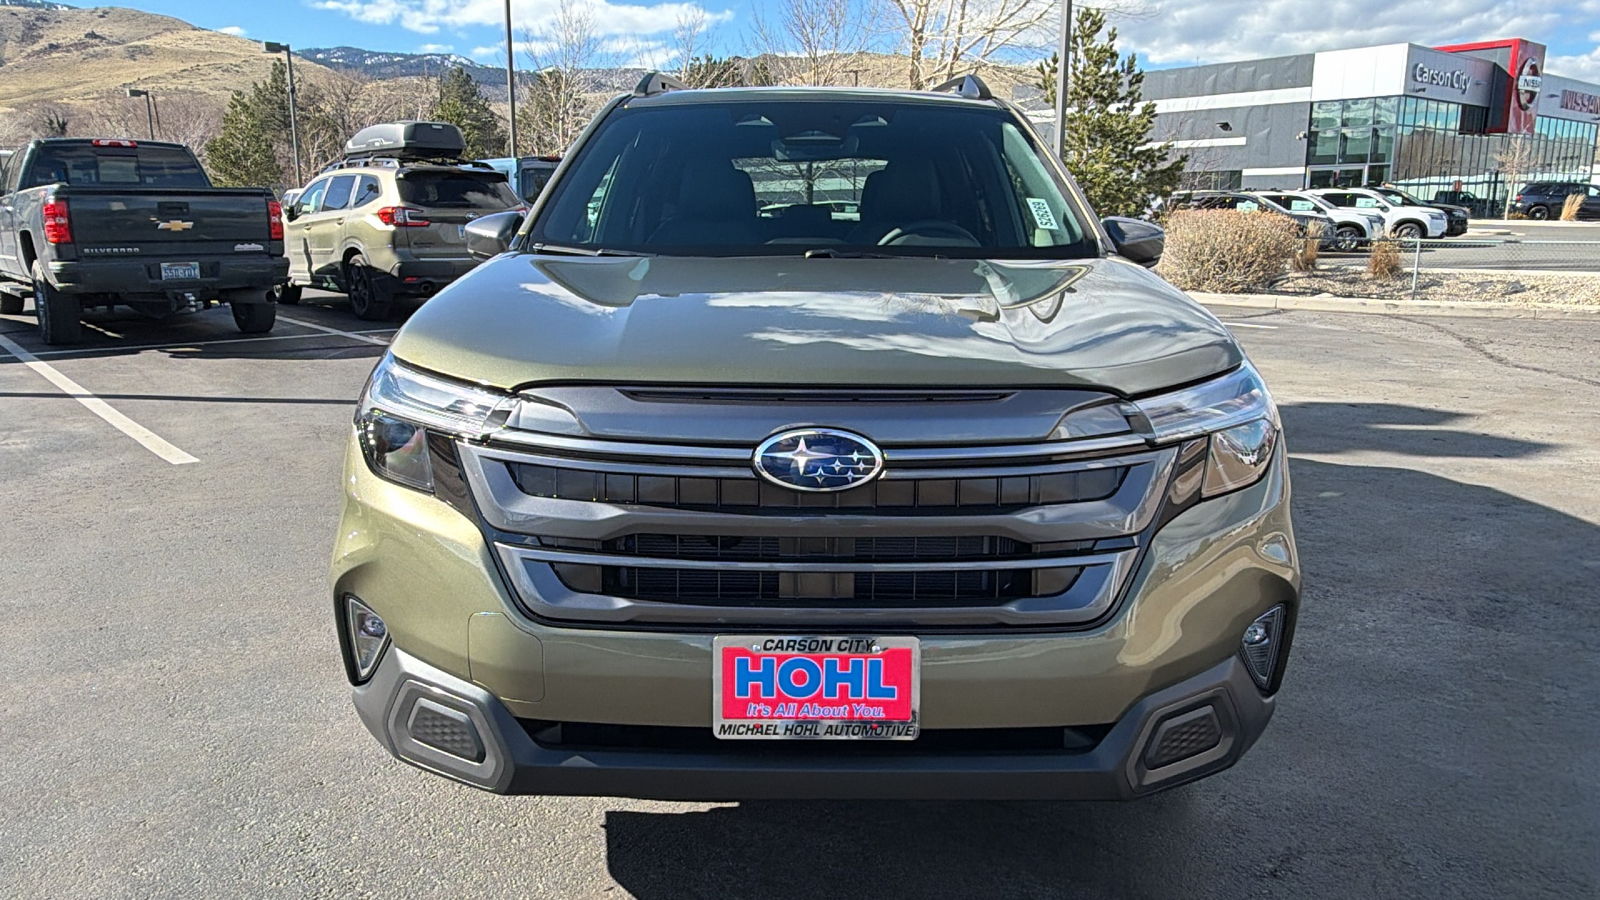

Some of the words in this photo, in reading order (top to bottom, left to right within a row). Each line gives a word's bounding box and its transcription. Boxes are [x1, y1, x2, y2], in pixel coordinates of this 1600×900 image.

[1415, 63, 1451, 87] Carson
[1452, 69, 1472, 95] City
[1562, 90, 1600, 114] NISSAN
[762, 638, 833, 652] CARSON
[836, 639, 876, 653] CITY
[735, 656, 898, 700] HOHL
[746, 702, 770, 717] It's
[774, 702, 797, 717] All
[799, 702, 850, 717] About
[851, 703, 886, 718] You.
[718, 723, 780, 736] MICHAEL
[783, 723, 820, 736] HOHL
[823, 723, 914, 737] AUTOMOTIVE
